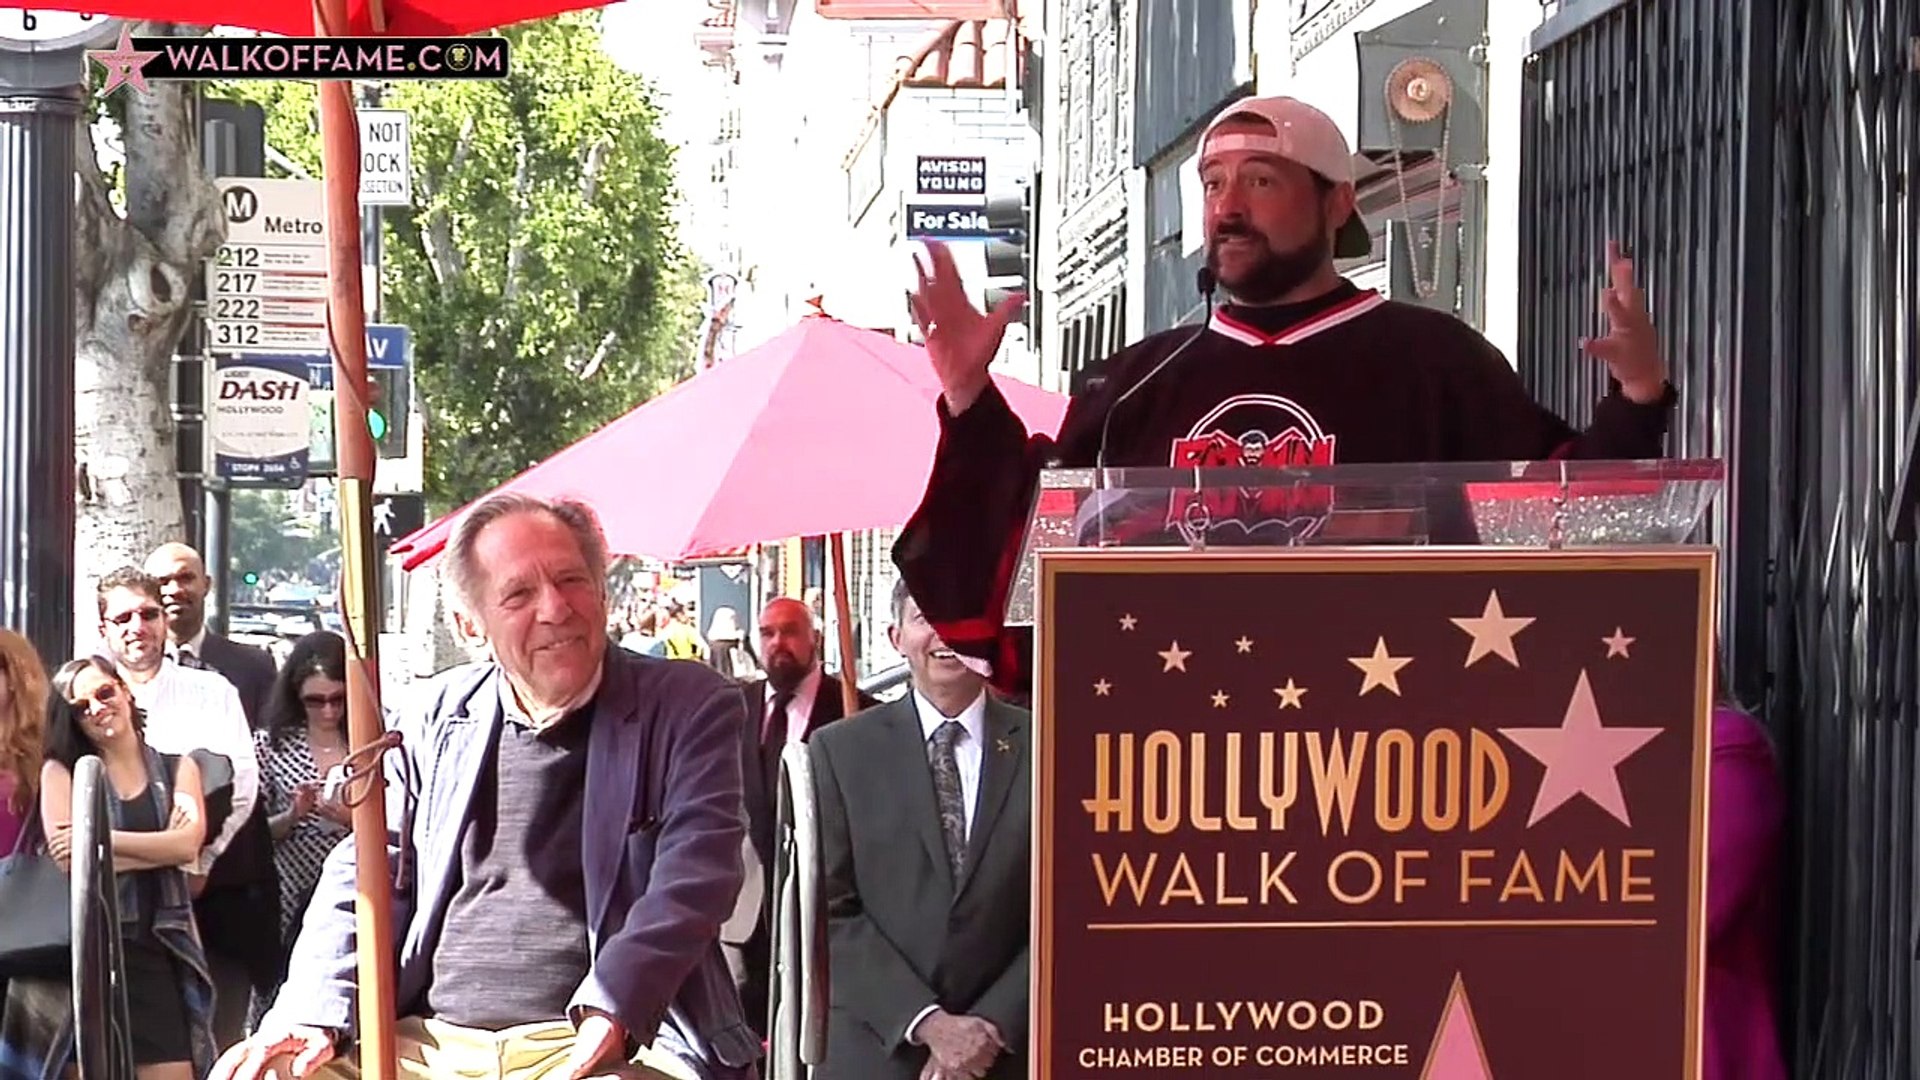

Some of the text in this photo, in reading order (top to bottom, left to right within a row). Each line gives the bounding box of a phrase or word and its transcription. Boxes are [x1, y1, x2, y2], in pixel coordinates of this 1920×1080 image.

[369, 122, 402, 142] NOT
[364, 153, 401, 173] OCK
[920, 160, 984, 173] AVISON
[920, 176, 984, 190] YOUNG
[226, 191, 253, 218] M
[264, 216, 324, 234] Metro
[913, 210, 946, 230] For
[216, 247, 260, 267] 212
[217, 273, 257, 293] 217
[217, 298, 260, 319] 222
[217, 324, 259, 344] 312
[219, 380, 301, 401] DASH
[1082, 726, 1510, 836] HOLLYWOOD
[1091, 848, 1656, 907] WALK OF FAME
[1103, 1000, 1385, 1032] HOLLYWOOD
[1078, 1044, 1409, 1068] CHAMBER OF COMMERCE
